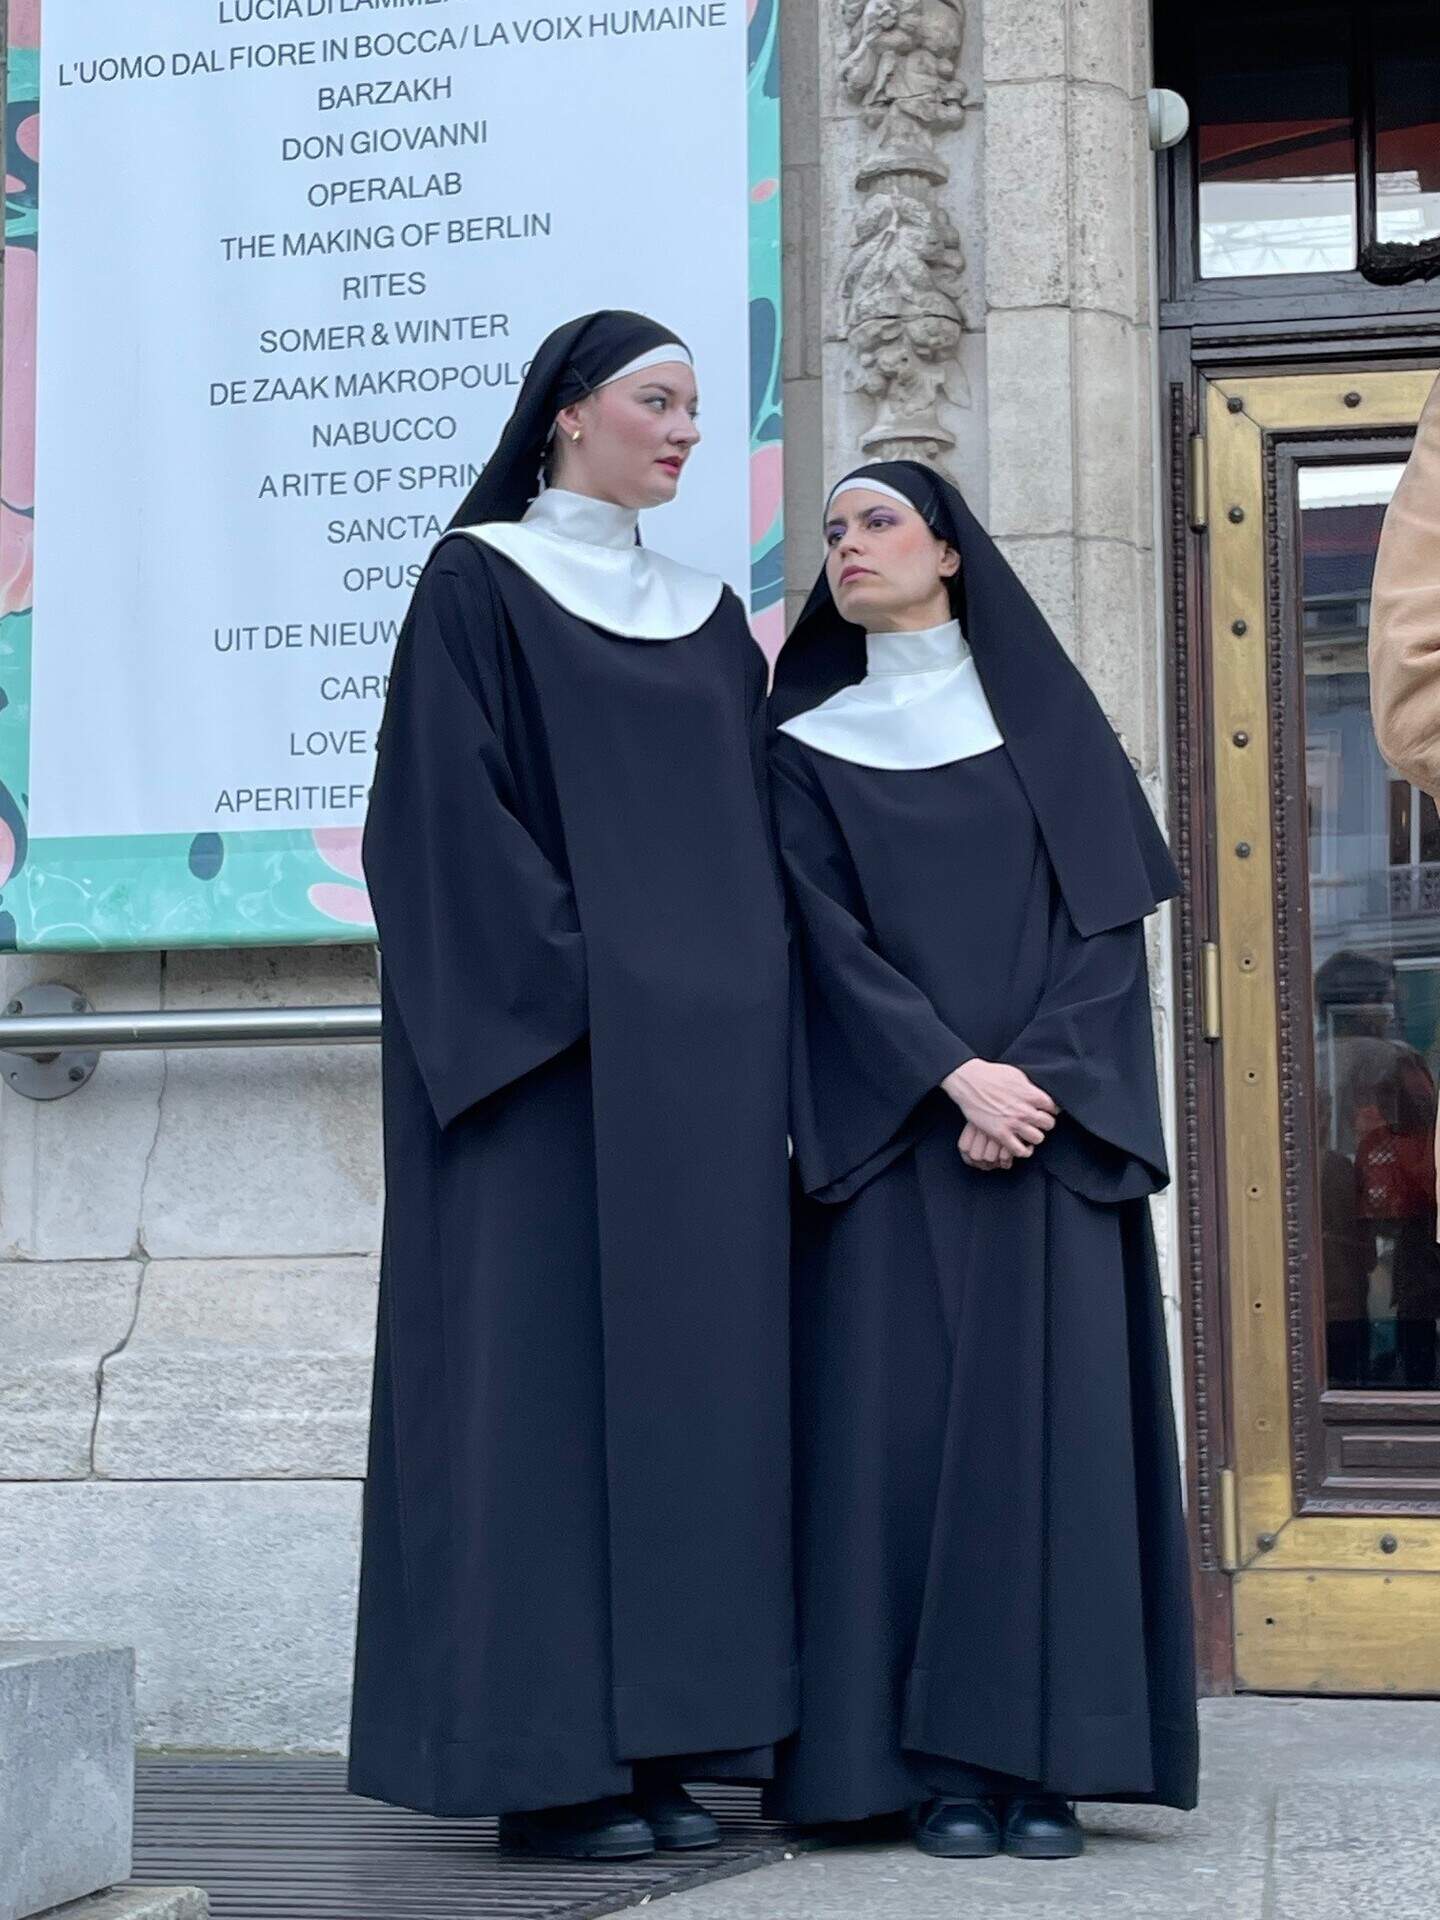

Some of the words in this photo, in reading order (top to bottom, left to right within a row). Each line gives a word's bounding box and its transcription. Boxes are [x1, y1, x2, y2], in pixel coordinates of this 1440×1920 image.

[219, 0, 303, 24] LUCIA
[307, 0, 330, 17] DI
[59, 53, 166, 88] L'UOMO
[172, 49, 225, 78] DAL
[230, 41, 316, 73] FIORE
[322, 37, 348, 63] IN
[354, 27, 458, 59] BOCCA
[474, 22, 510, 47] LA
[512, 17, 583, 44] VOIX
[589, 2, 727, 37] HUMAINE
[318, 75, 452, 111] BARZAKH
[282, 134, 344, 162] DON
[350, 119, 487, 156] GIOVANNI
[307, 171, 463, 208] OPERALAB
[220, 232, 276, 262] THE
[282, 223, 395, 257] MAKING
[400, 221, 441, 247] OF
[447, 212, 551, 244] BERLIN
[343, 271, 426, 301] RITES
[259, 324, 366, 354] SOMER
[371, 322, 390, 347] &
[394, 313, 509, 344] WINTER
[210, 380, 248, 407] DE
[252, 373, 329, 405] ZAAK
[312, 415, 457, 448] NABUCCO
[257, 475, 278, 499] A
[282, 471, 348, 497] RITE
[353, 467, 393, 494] OF
[327, 513, 442, 544] SANCTA
[343, 563, 423, 592] OPUS
[214, 626, 260, 653] UIT
[264, 624, 303, 650] DE
[310, 619, 401, 647] NIEUW
[290, 729, 368, 756] LOVE
[214, 784, 372, 814] APERITIEF
